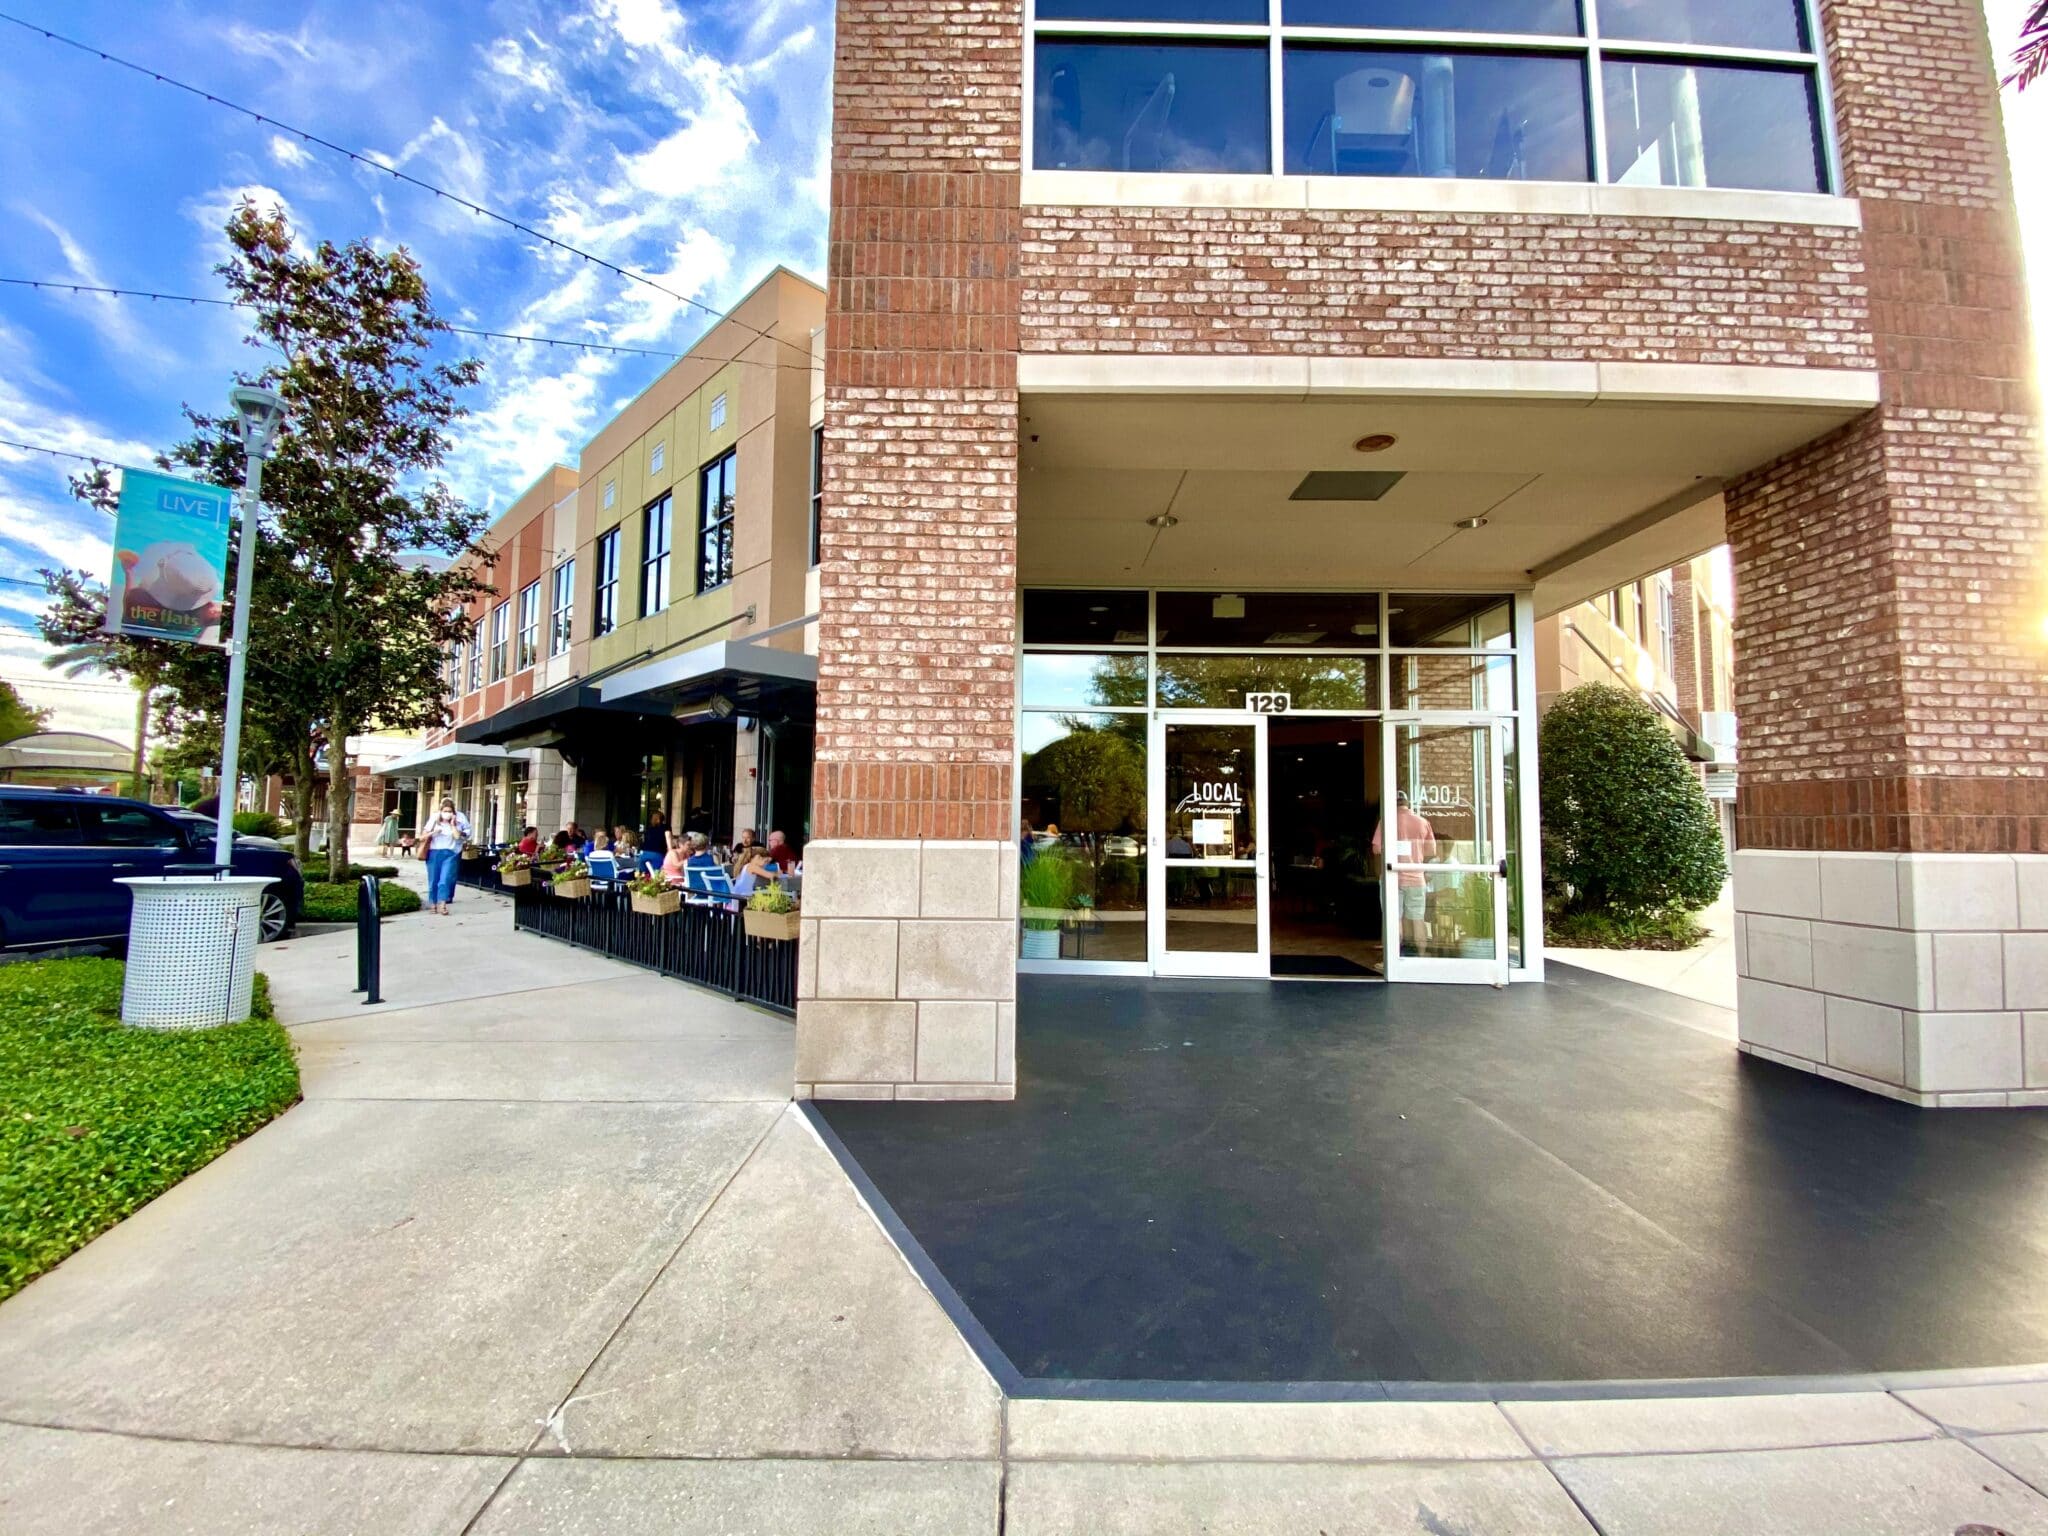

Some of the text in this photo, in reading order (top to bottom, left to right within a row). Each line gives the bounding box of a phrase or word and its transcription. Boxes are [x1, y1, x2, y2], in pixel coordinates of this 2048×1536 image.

[163, 494, 209, 517] LIVE
[130, 605, 199, 626] the flats
[1250, 695, 1288, 713] 129
[1193, 782, 1243, 801] LOCAL
